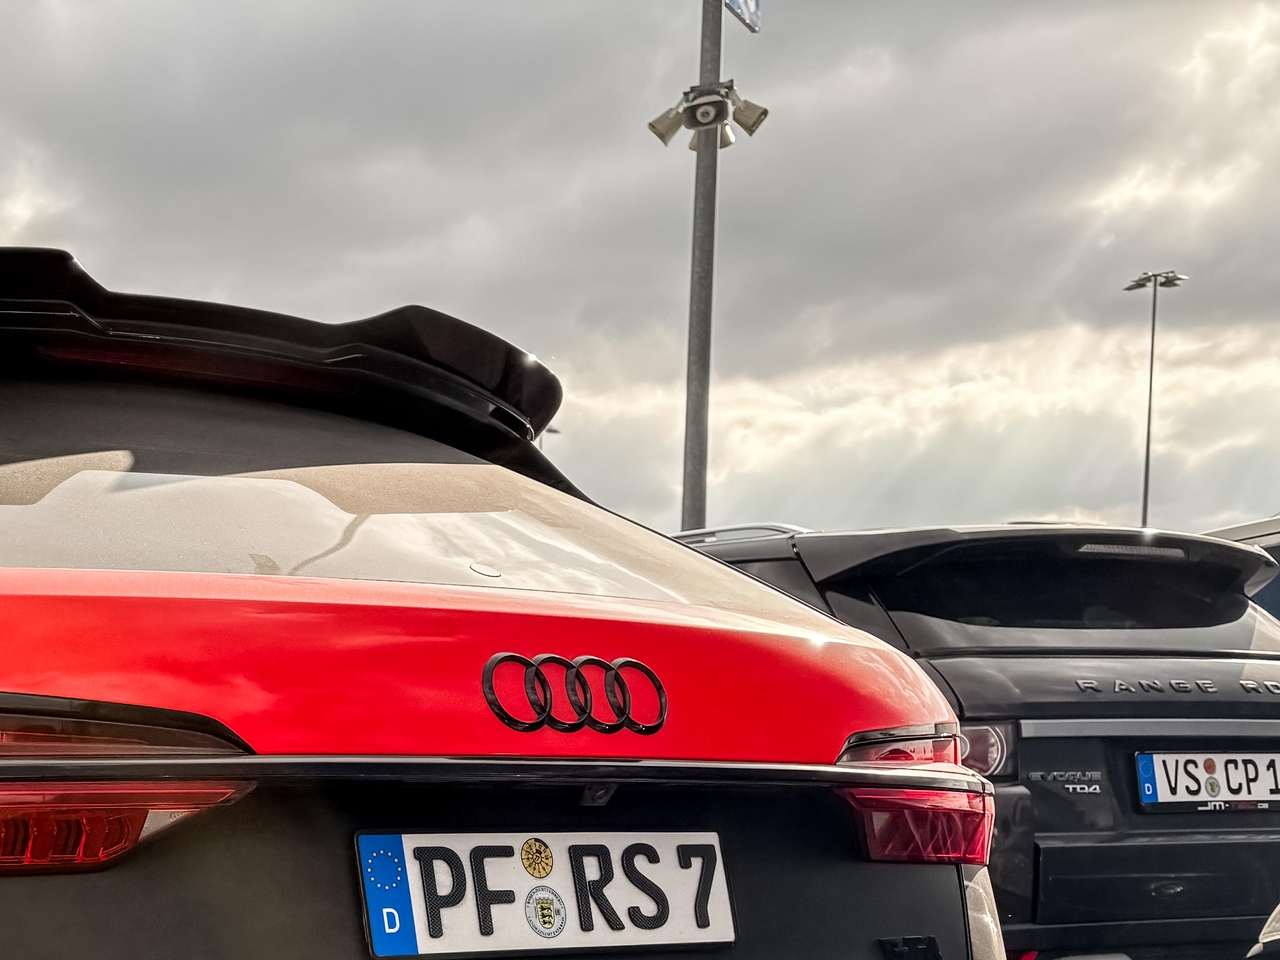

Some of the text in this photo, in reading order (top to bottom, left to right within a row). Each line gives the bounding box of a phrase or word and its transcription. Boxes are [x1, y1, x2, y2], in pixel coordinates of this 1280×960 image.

[1076, 679, 1218, 693] RANGE
[1029, 771, 1102, 782] EVOQUE
[1144, 783, 1153, 795] D
[1162, 758, 1202, 796] VS
[1224, 758, 1260, 796] CP
[1064, 784, 1102, 794] TD4
[382, 907, 401, 934] D
[413, 845, 516, 939] PF
[568, 842, 670, 932] RS
[677, 843, 718, 929] 7
